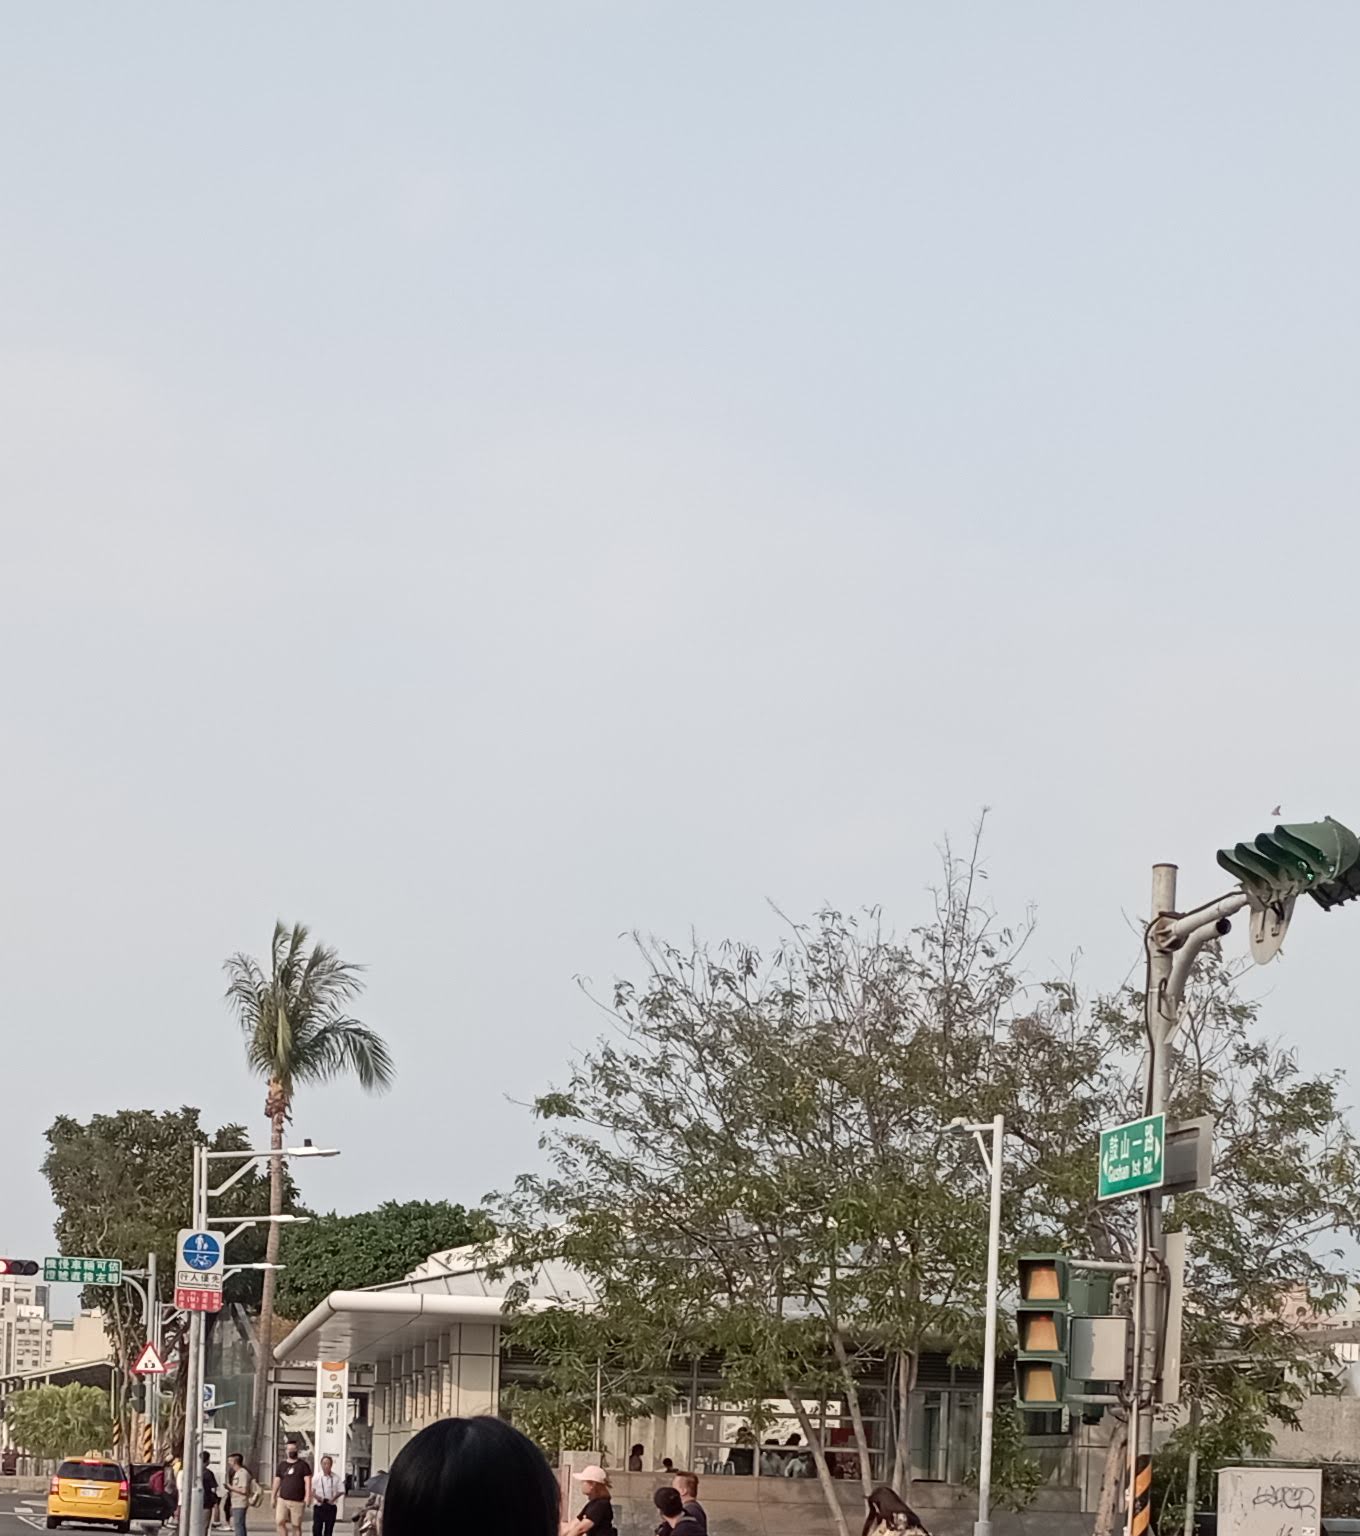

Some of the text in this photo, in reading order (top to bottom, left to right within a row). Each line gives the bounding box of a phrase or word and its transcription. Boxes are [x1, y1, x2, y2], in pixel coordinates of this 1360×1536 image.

[1109, 1123, 1154, 1162] 鼓山一路
[1108, 1165, 1130, 1183] Gushan
[1131, 1159, 1141, 1177] 1st
[180, 1273, 220, 1283] 行人優先
